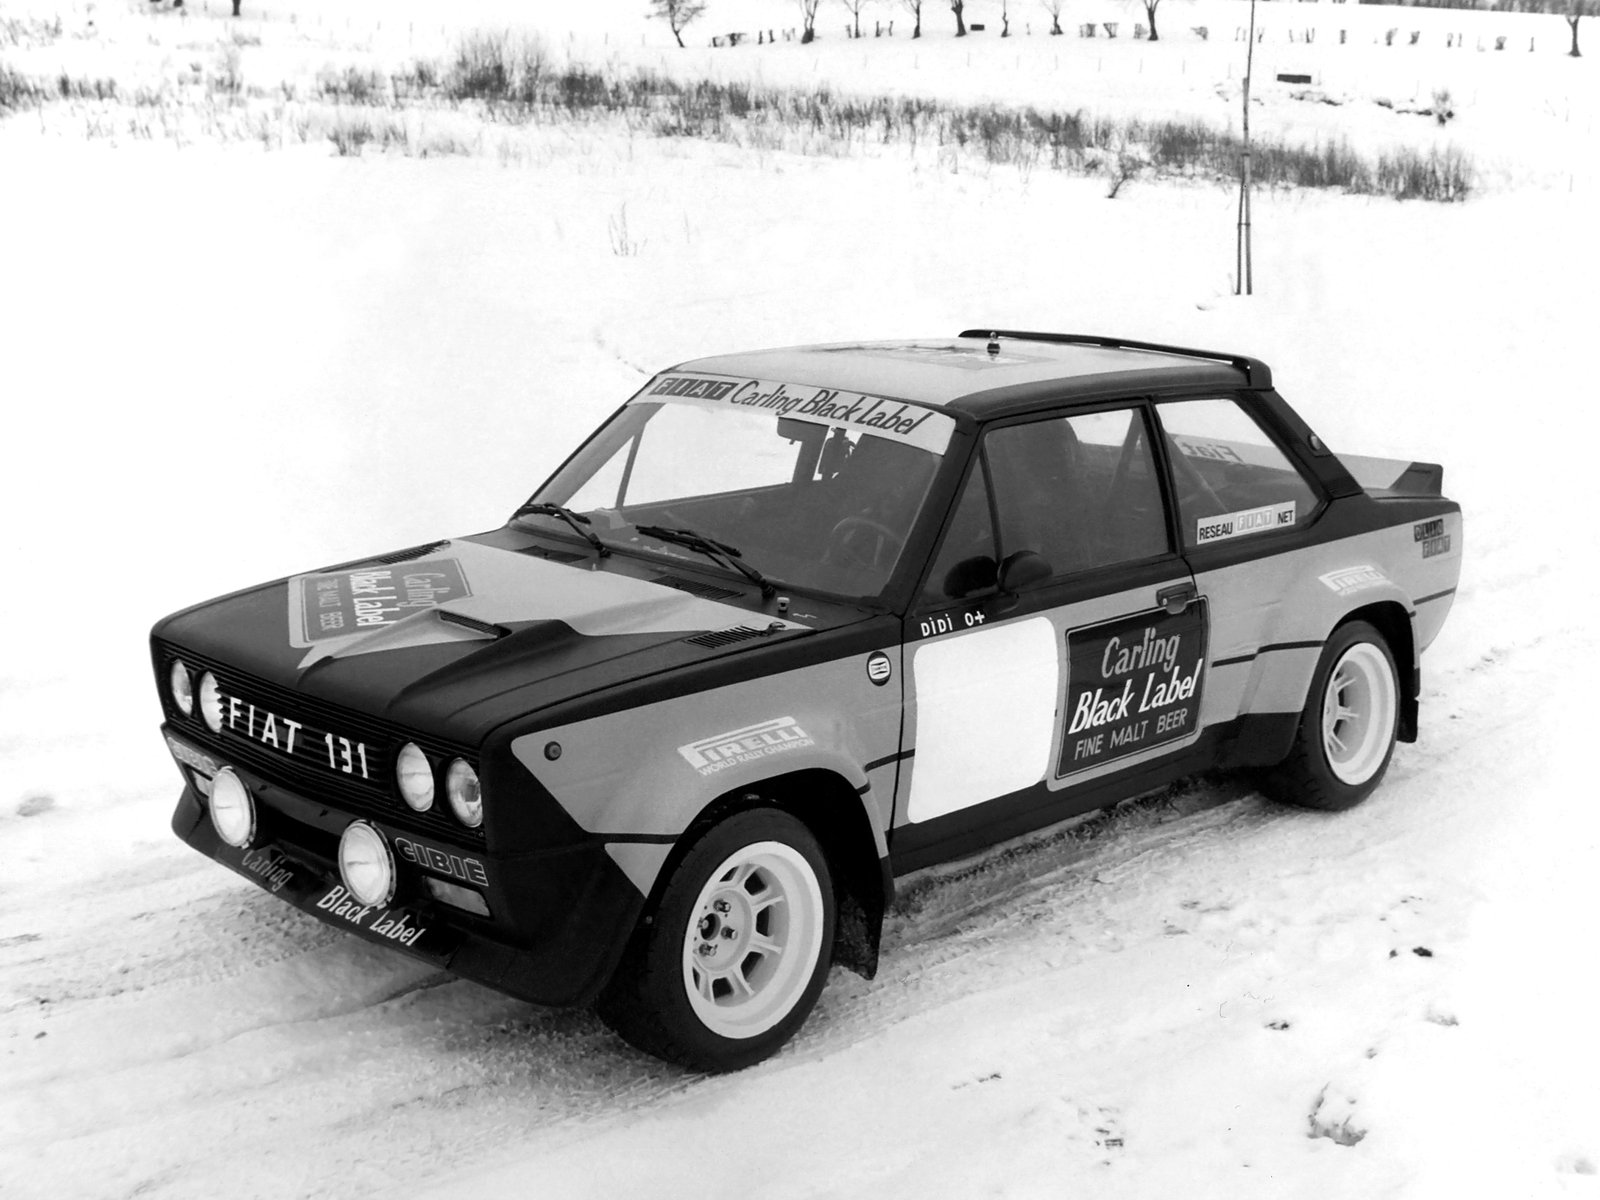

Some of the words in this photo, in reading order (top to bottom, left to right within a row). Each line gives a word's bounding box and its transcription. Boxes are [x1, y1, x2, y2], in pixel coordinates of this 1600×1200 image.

[650, 378, 738, 400] FIAT
[730, 381, 803, 416] Carling
[798, 389, 866, 422] Black
[854, 399, 934, 436] Label
[1199, 522, 1233, 540] RESEAU
[1237, 509, 1273, 531] FIAT
[1277, 510, 1293, 525] NET
[350, 570, 395, 596] Black
[396, 573, 451, 608] Carling
[320, 611, 344, 631] BEER
[353, 595, 400, 627] Label
[1101, 627, 1181, 679] Carling
[1068, 678, 1136, 735] Black
[1138, 658, 1204, 713] Label
[229, 696, 302, 754] FIAT
[325, 732, 368, 779] 131
[677, 715, 808, 770] PIRELLI
[698, 757, 737, 776] WORLD
[736, 749, 766, 763] RALLY
[764, 738, 815, 755] CHAMPION
[1074, 734, 1104, 760] FINE
[1110, 720, 1149, 750] MALT
[1156, 708, 1188, 735] BEER
[241, 849, 294, 893] Carling
[316, 885, 371, 925] Black
[369, 909, 426, 947] Label
